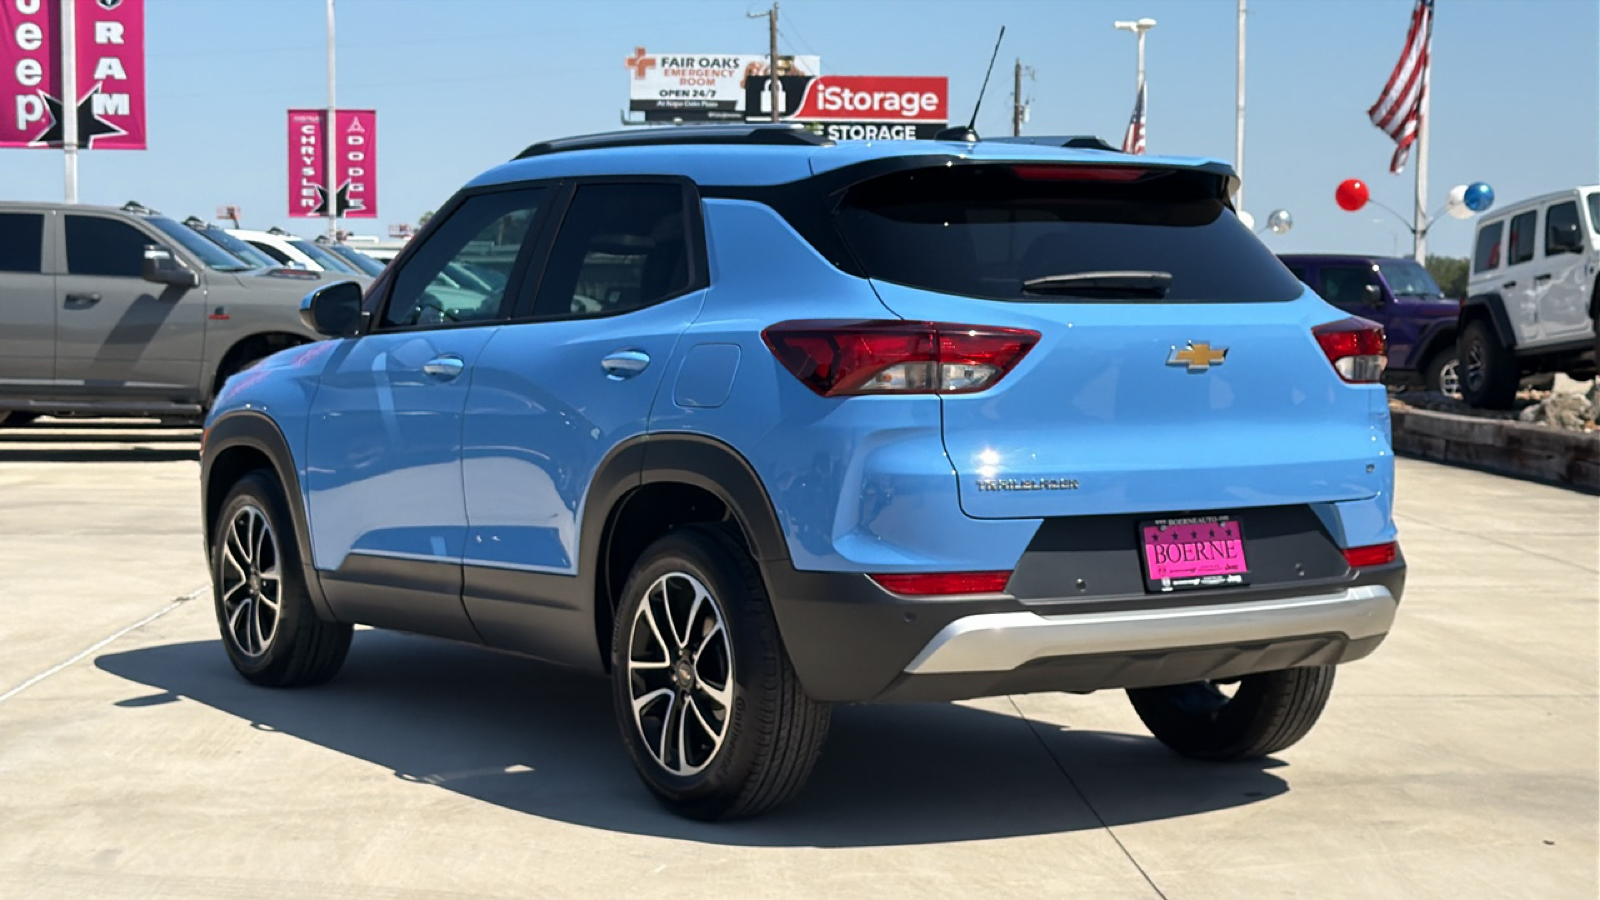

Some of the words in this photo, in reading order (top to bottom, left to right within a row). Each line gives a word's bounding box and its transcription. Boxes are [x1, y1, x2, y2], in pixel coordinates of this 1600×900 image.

[93, 21, 130, 115] RAM
[660, 57, 693, 68] FAIR
[699, 57, 740, 68] OAKS
[664, 69, 735, 78] EMERGENCY
[679, 79, 716, 87] ROOM
[659, 89, 690, 98] OPEN
[692, 89, 717, 98] 24/7
[816, 84, 940, 117] iStorage
[828, 125, 916, 140] STORAGE
[1154, 540, 1238, 565] BOERNE
